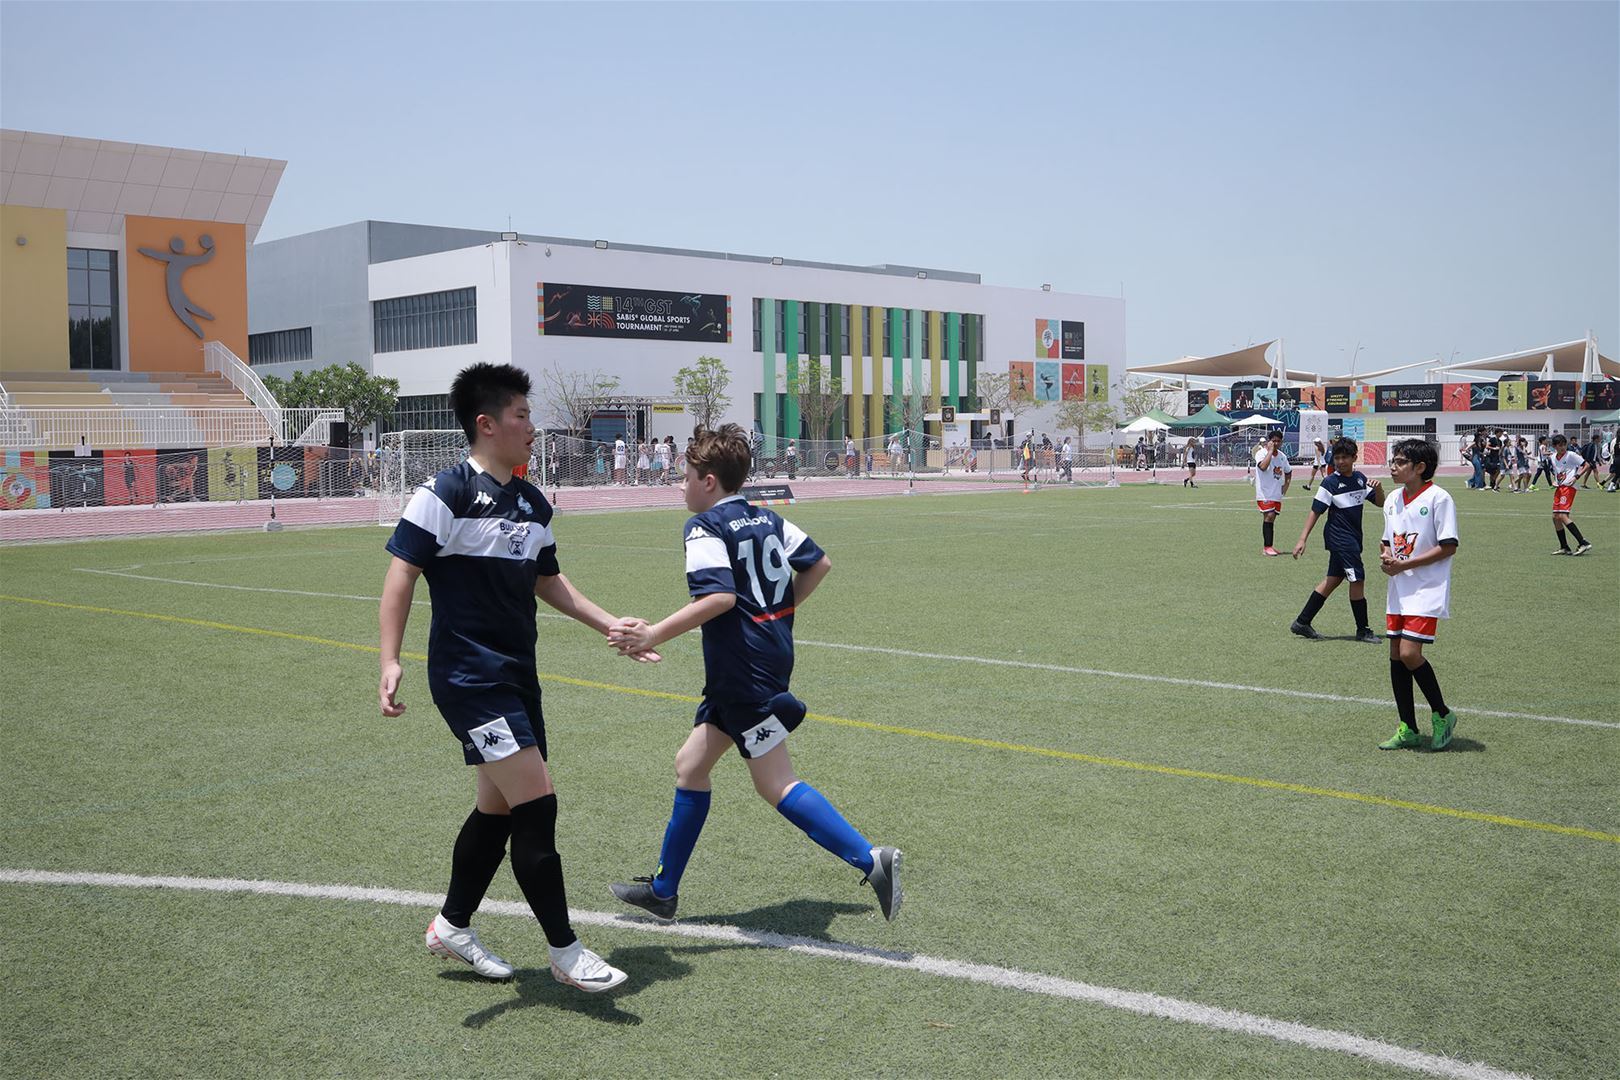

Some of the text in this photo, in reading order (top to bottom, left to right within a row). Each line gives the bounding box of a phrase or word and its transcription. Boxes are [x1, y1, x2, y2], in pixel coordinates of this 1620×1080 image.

[644, 298, 673, 314] GST
[640, 314, 666, 323] GLOBAL
[667, 316, 691, 324] SPORTS
[616, 322, 662, 331] TOURNAMENT
[737, 534, 792, 608] 19
